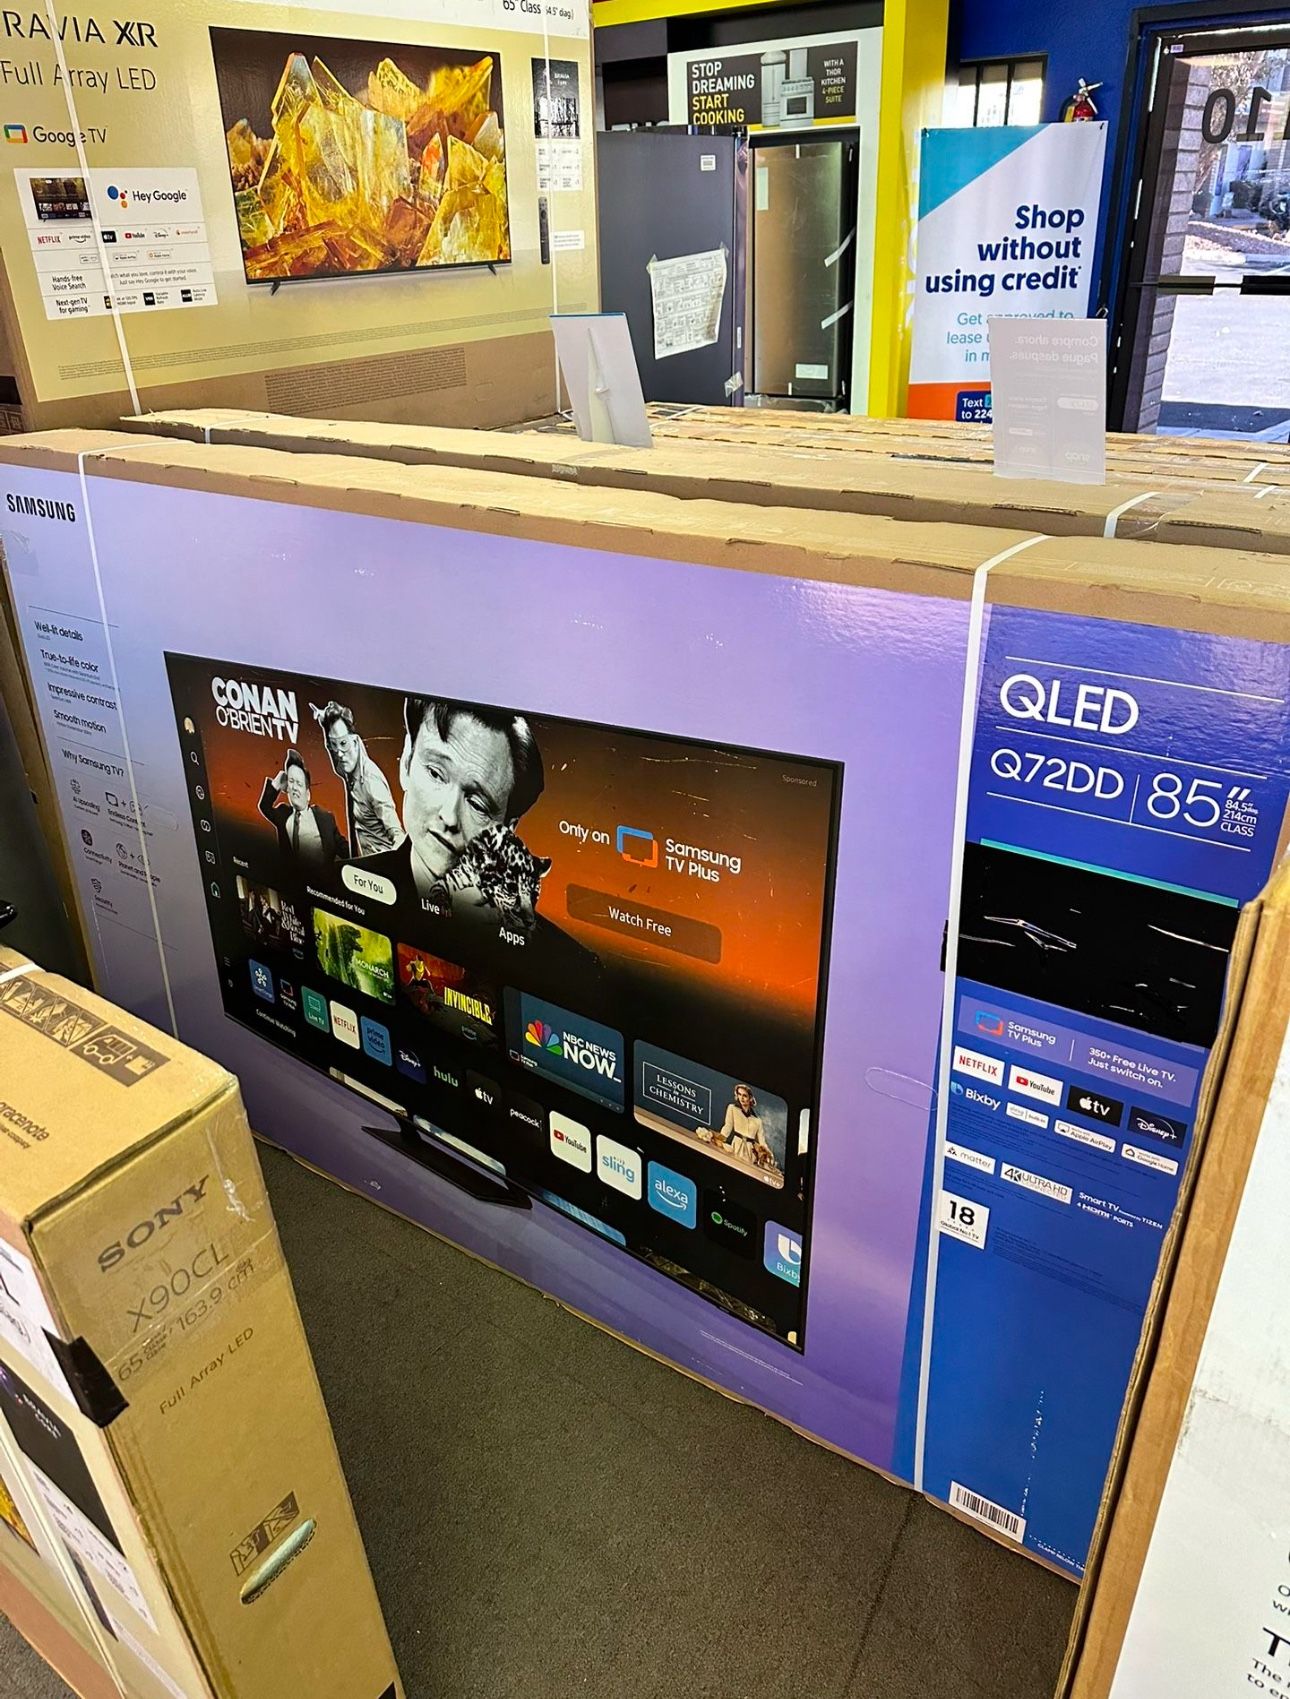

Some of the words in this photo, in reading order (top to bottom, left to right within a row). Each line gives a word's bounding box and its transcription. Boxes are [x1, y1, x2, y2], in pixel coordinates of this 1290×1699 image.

[520, 0, 541, 14] Class
[3, 10, 105, 44] RAVIA
[113, 20, 158, 47] XR
[691, 61, 722, 79] STOP
[823, 59, 838, 68] WITH
[826, 67, 842, 76] THOR
[0, 60, 43, 86] Full
[54, 63, 108, 94] Array
[117, 67, 156, 91] LED
[692, 73, 755, 95] DREAMING
[821, 76, 846, 86] KITCHEN
[822, 86, 844, 95] 4-PIECE
[825, 94, 842, 103] SUITE
[692, 93, 729, 111] START
[693, 108, 745, 125] COOKING
[33, 126, 87, 147] Googe
[88, 128, 107, 144] TV
[132, 191, 151, 203] Hey
[152, 190, 187, 203] Google
[1015, 204, 1085, 233] Shop
[37, 235, 61, 244] NETFLIX
[977, 236, 1082, 261] without
[52, 274, 83, 283] Hands-free
[52, 283, 67, 291] Voice
[67, 282, 87, 290] Search
[925, 268, 995, 297] using
[56, 298, 80, 306] Next-gen
[59, 306, 67, 314] for
[68, 306, 88, 315] gaming
[957, 311, 983, 325] Get
[946, 331, 983, 344] lease
[965, 349, 977, 362] in
[962, 397, 983, 408] Text
[961, 410, 972, 420] to
[6, 493, 76, 523] SAMSUNG
[34, 620, 59, 636] Well-lit
[59, 625, 84, 642] details
[40, 648, 80, 668] True-to-life
[80, 660, 99, 673] color
[47, 682, 86, 701] Impressive
[86, 692, 118, 711] contrast
[211, 676, 299, 723] CONAN
[999, 673, 1140, 735] QLED
[53, 708, 81, 726] Smooth
[81, 716, 107, 734] motion
[62, 748, 78, 763] Why
[78, 753, 112, 775] Samsung
[112, 765, 124, 777] TV?
[782, 774, 817, 787] Sponsored
[990, 748, 1124, 800] Q72DD
[1222, 808, 1257, 825] 214cm
[558, 820, 588, 840] Only
[591, 829, 610, 845] on
[1220, 821, 1255, 837] CLASS
[665, 838, 742, 874] Samsung
[665, 855, 684, 873] TV
[688, 861, 720, 883] Plus
[306, 885, 345, 908] Recommended
[345, 900, 354, 910] for
[354, 904, 366, 916] You
[353, 874, 367, 887] For
[366, 879, 384, 895] You
[421, 898, 440, 915] Live
[499, 926, 525, 946] Apps
[608, 905, 643, 929] Watch
[646, 917, 672, 937] Free
[357, 960, 389, 979] MONARCH
[444, 987, 493, 1026] INVINCIBLE
[333, 1015, 356, 1035] NETFLIX
[366, 1026, 384, 1041] prime
[1007, 1021, 1056, 1045] Samsung
[367, 1034, 385, 1049] video
[562, 1031, 584, 1049] NBC
[586, 1040, 616, 1062] NEWS
[1007, 1029, 1021, 1041] TV
[1021, 1033, 1043, 1048] Plus
[1088, 1047, 1111, 1061] 350+
[1112, 1051, 1136, 1070] Free
[1137, 1060, 1160, 1076] Live
[1161, 1068, 1177, 1082] TV.
[1088, 1057, 1109, 1070] Just
[1110, 1063, 1146, 1081] switch
[1146, 1077, 1163, 1089] on.
[433, 1065, 459, 1087] hulu
[656, 1073, 697, 1098] LESSONS
[483, 1091, 493, 1105] tv
[650, 1085, 704, 1115] CHEMISTRY
[959, 1054, 998, 1077] NETFLIX
[1029, 1080, 1055, 1096] YouTube
[1092, 1098, 1111, 1117] tv
[1136, 1117, 1177, 1140] Disney+
[965, 1088, 1001, 1111] Bixby
[510, 1108, 541, 1128] peacock
[564, 1135, 588, 1153] YouTube
[1071, 1130, 1090, 1143] Apple
[1090, 1137, 1112, 1150] AirPlay
[602, 1156, 635, 1183] sling
[1138, 1155, 1157, 1166] Google
[960, 1151, 992, 1169] matter
[1004, 1168, 1022, 1182] 4K
[1022, 1172, 1053, 1190] ULTRA
[1053, 1183, 1069, 1196] HD
[654, 1179, 689, 1204] alexa
[950, 1200, 975, 1226] 18
[1079, 1191, 1107, 1208] Smart
[1107, 1203, 1119, 1213] TV
[1142, 1217, 1164, 1230] TIZEN
[97, 1174, 210, 1274] SONY
[723, 1219, 748, 1238] Spotify
[1113, 1216, 1134, 1228] PORTS
[127, 1243, 229, 1333] X90CL
[119, 1352, 143, 1382] 65
[175, 1287, 223, 1331] 163.9
[227, 1262, 255, 1291] cm
[159, 1386, 186, 1415] Full
[190, 1353, 224, 1389] Array
[228, 1327, 254, 1354] LED
[1247, 1673, 1265, 1688] to
[1252, 1657, 1282, 1683] The
